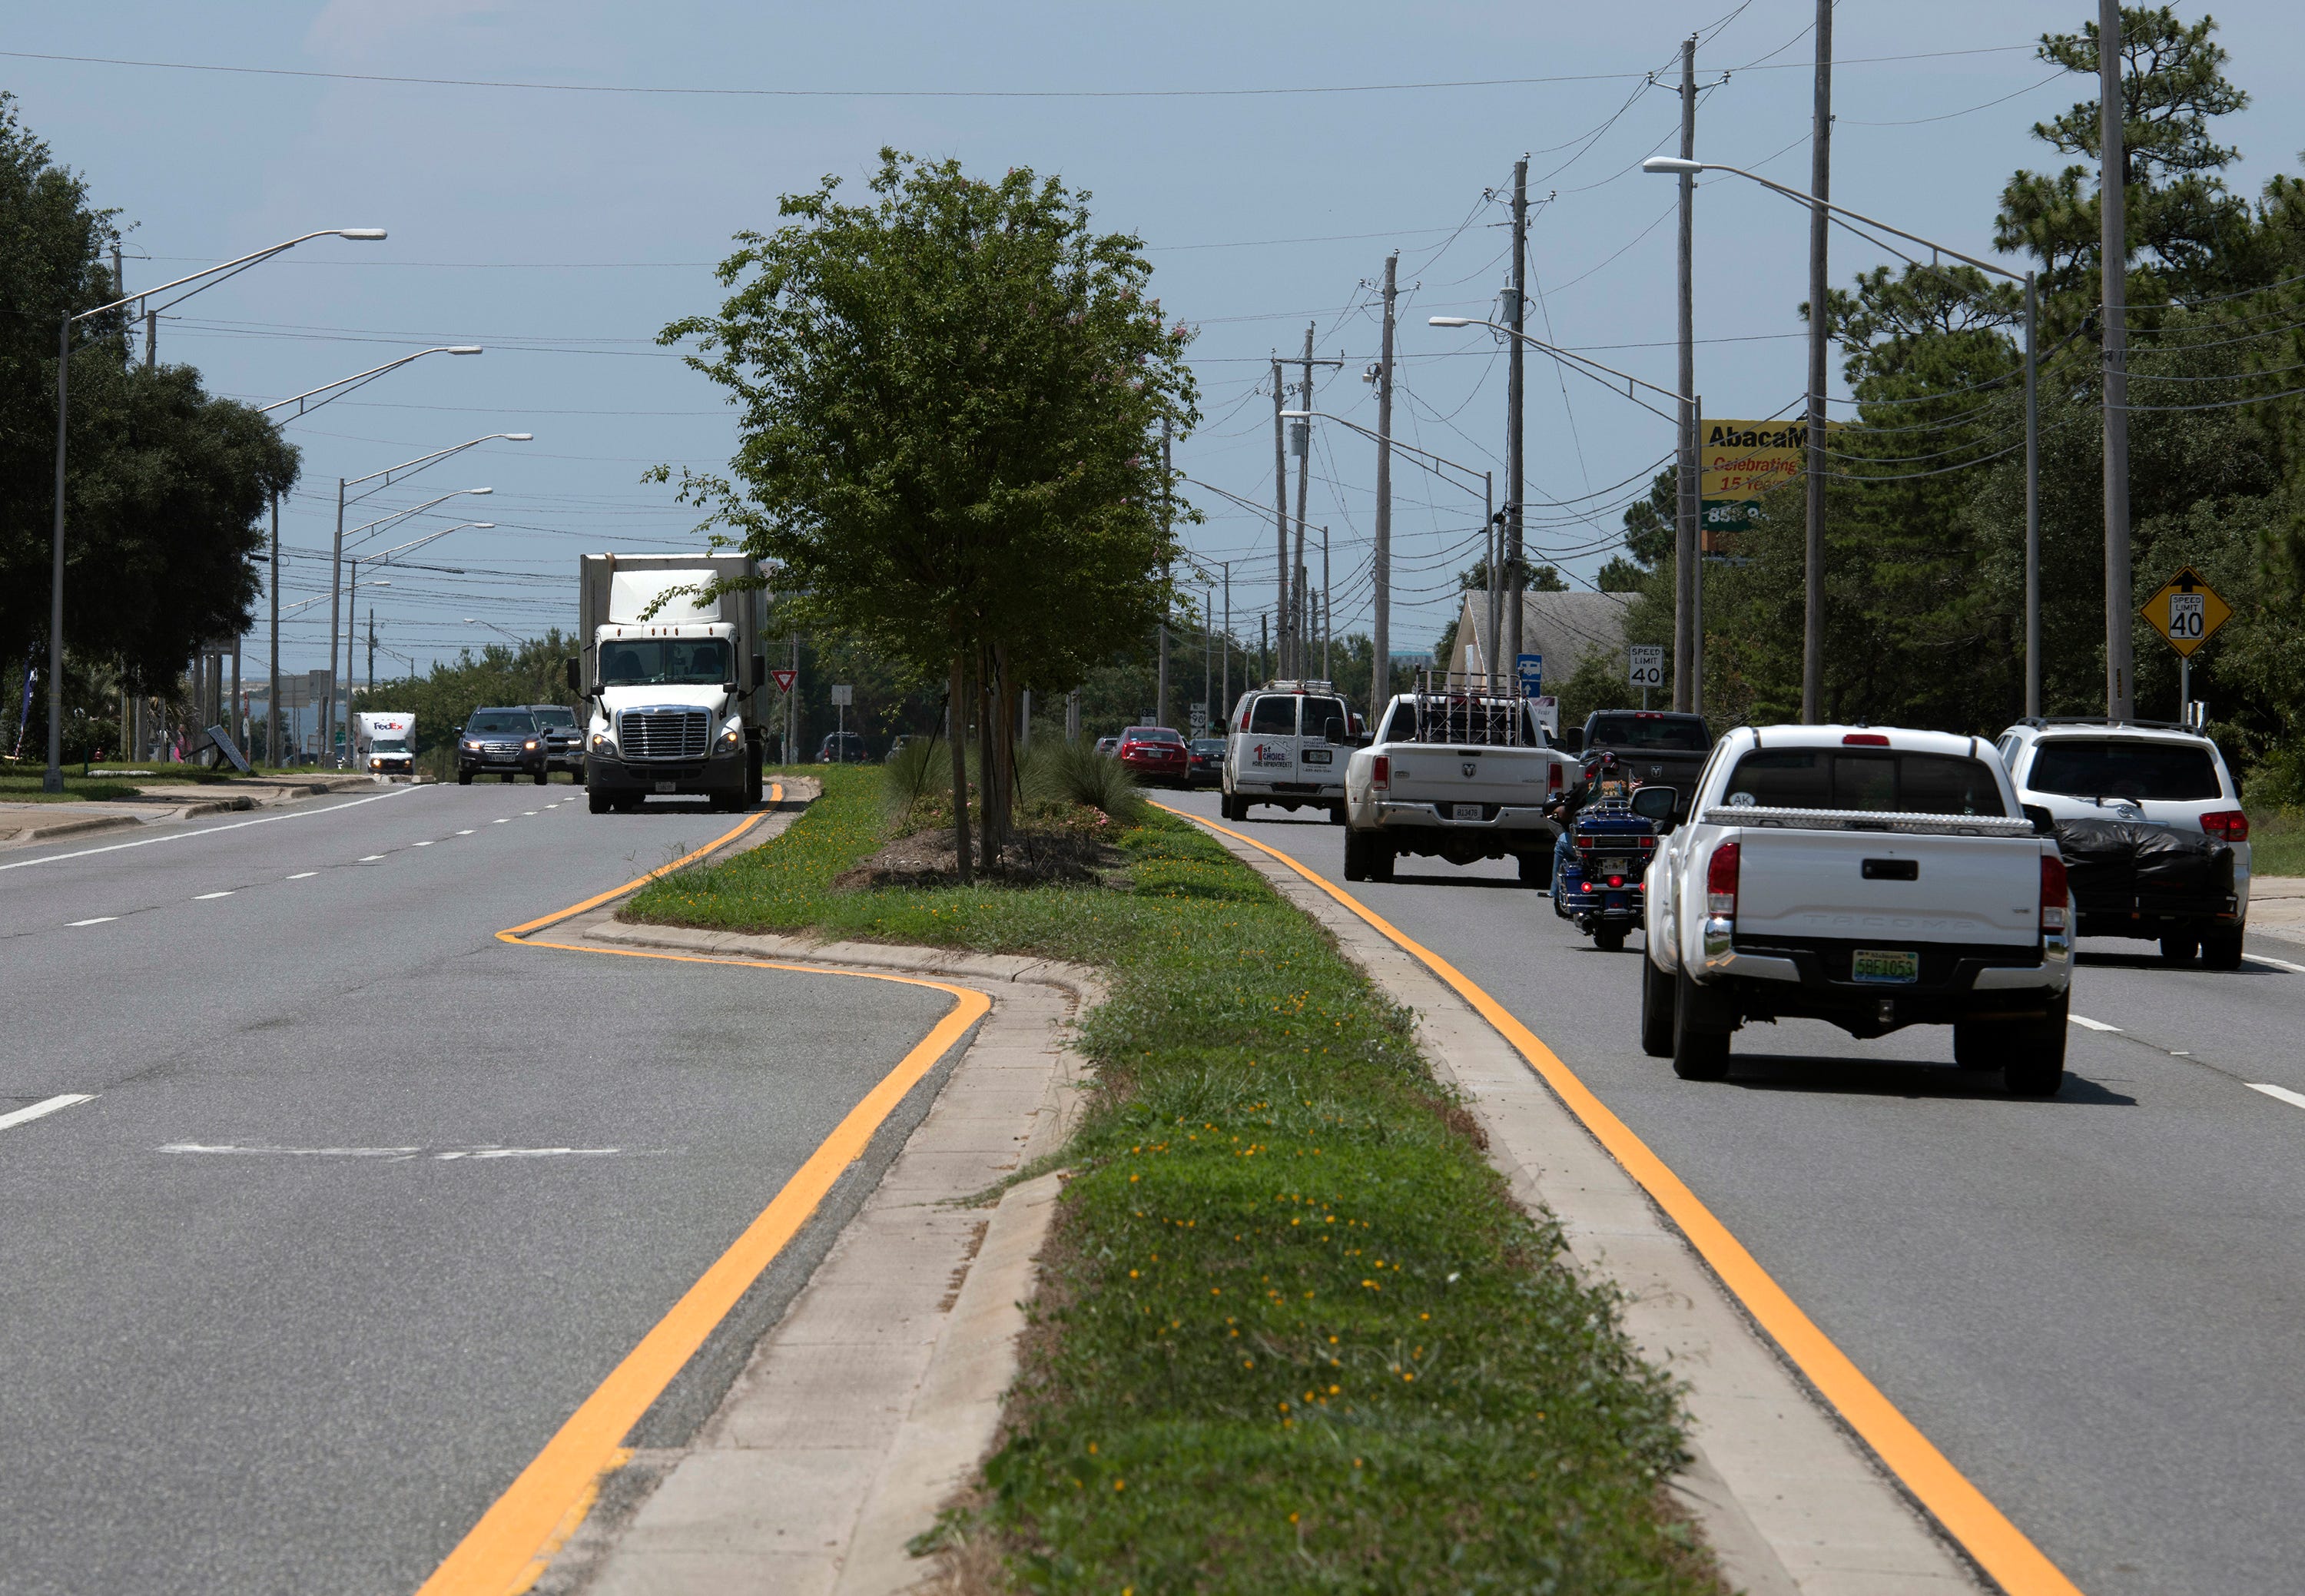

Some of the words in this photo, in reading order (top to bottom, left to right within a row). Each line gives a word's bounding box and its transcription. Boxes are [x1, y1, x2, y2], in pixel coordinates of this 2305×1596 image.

[1709, 426, 1830, 449] AbacaM
[1713, 456, 1799, 475] Celebrating
[1720, 476, 1741, 491] 15
[2171, 612, 2203, 636] 40
[1631, 667, 1660, 683] 40
[373, 722, 403, 731] FedEx
[1192, 715, 1204, 724] 98
[1253, 744, 1272, 762] 1st
[1262, 752, 1285, 762] CHOICE
[1733, 795, 1751, 806] AK
[1457, 808, 1478, 817] 813478
[1803, 914, 1975, 930] TACOMA
